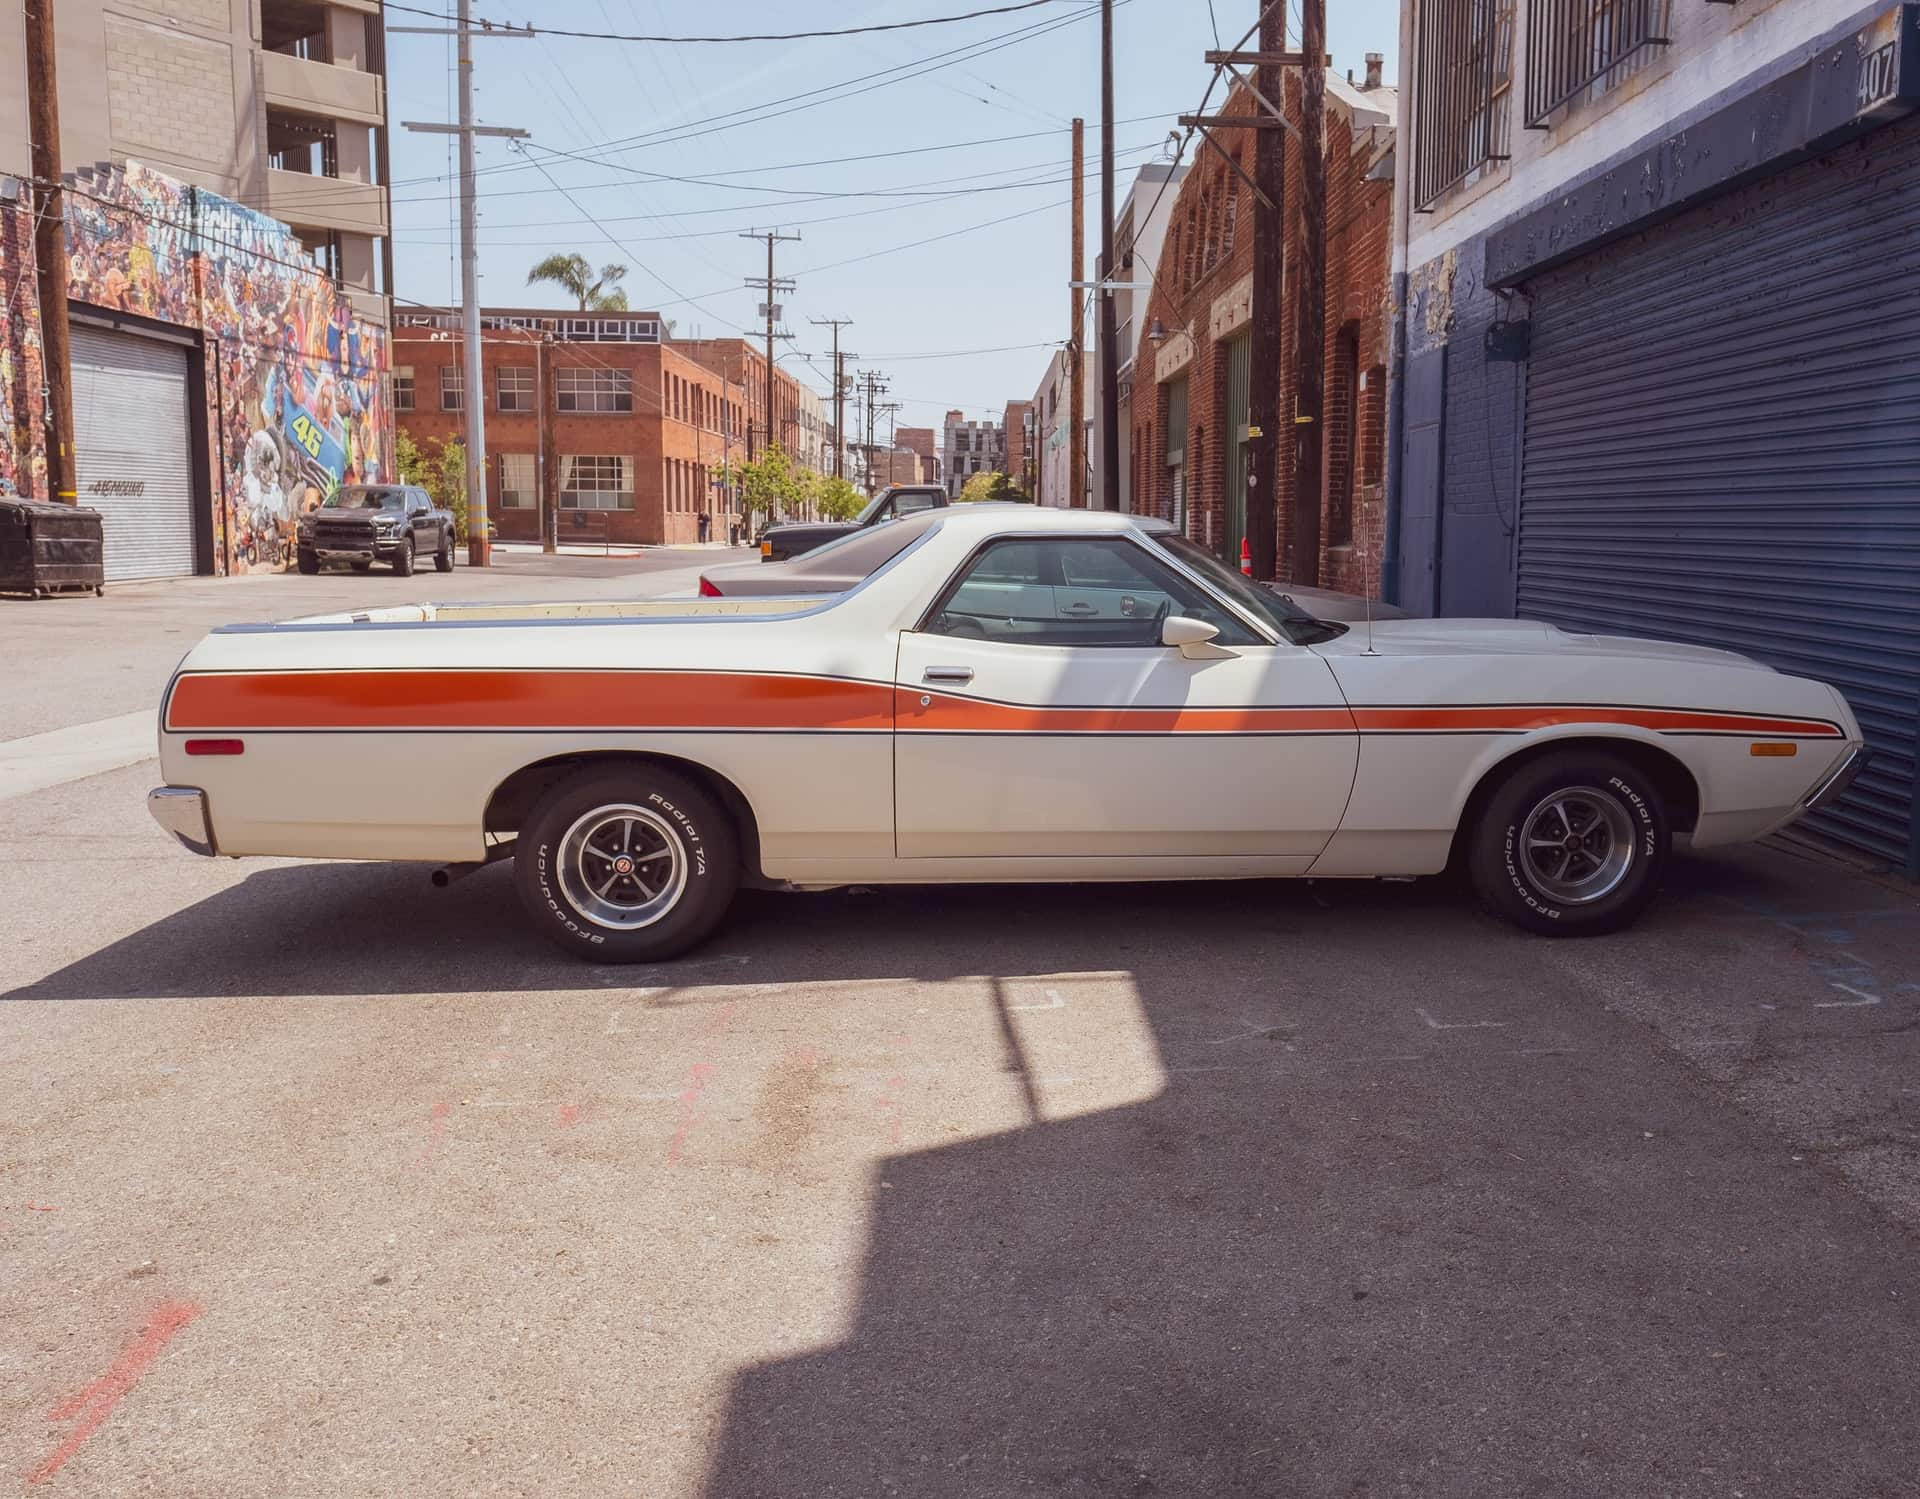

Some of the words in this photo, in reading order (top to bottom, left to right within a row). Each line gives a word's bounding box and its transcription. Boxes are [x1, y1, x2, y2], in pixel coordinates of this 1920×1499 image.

[1857, 45, 1894, 105] 407
[292, 415, 323, 459] 46
[648, 793, 700, 842] Radial
[695, 847, 706, 876] T/A
[1608, 776, 1652, 824] Radial
[1645, 829, 1655, 856] T/A
[537, 844, 606, 944] BFGoodrich
[1504, 824, 1561, 919] BFGoodrich
